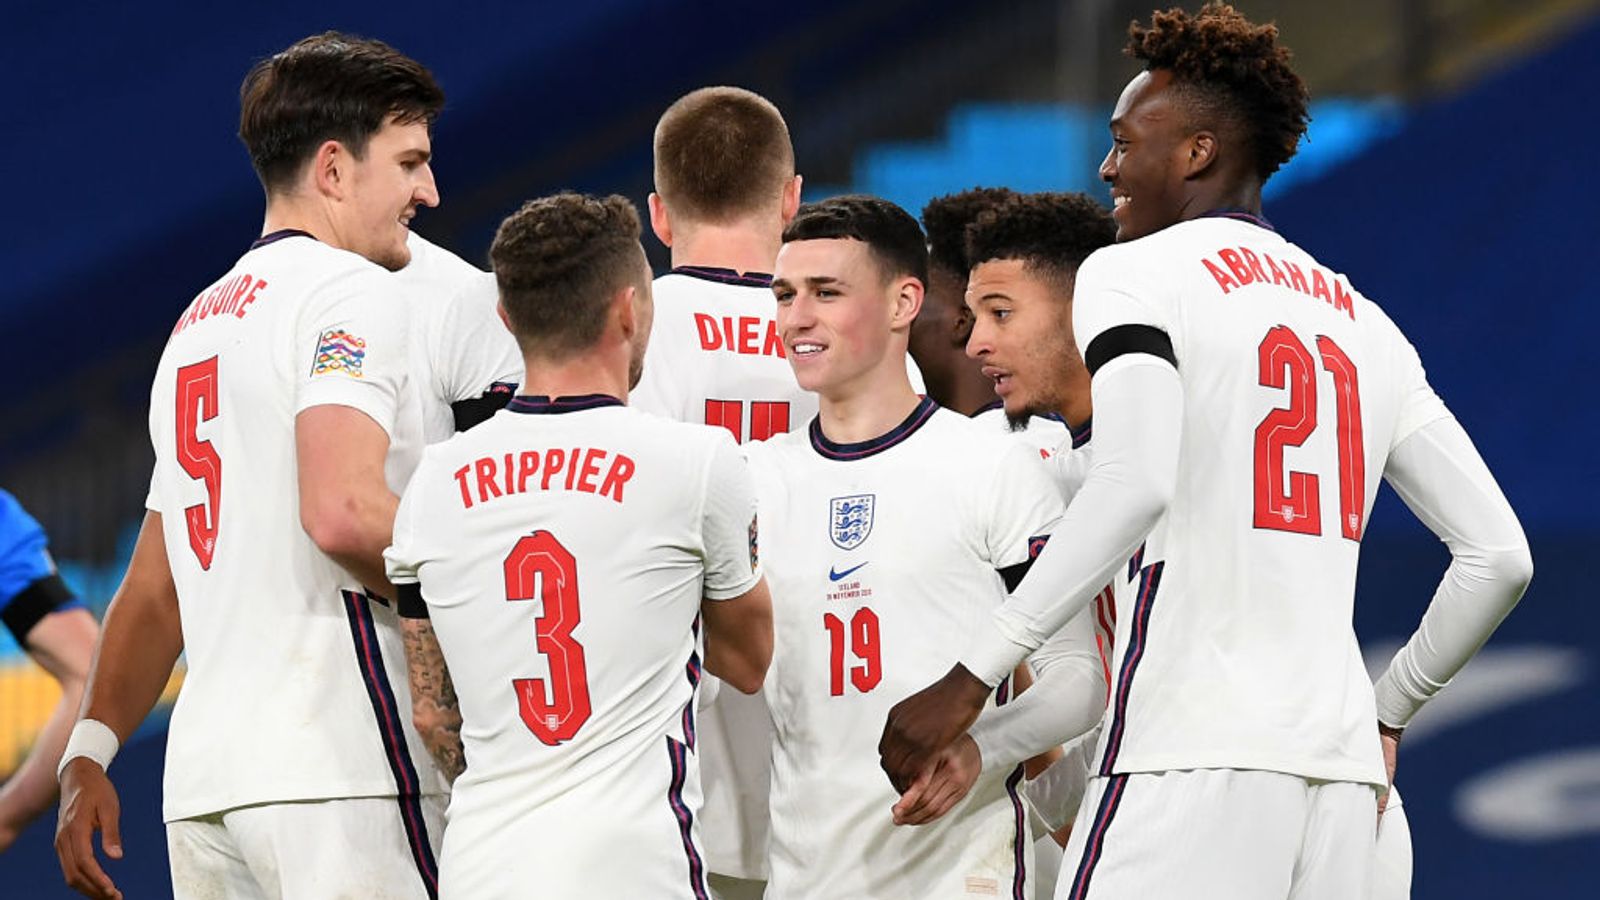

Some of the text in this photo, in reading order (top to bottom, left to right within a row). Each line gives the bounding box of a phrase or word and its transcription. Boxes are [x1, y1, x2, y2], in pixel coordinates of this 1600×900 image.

[1201, 246, 1355, 321] ABRAHAM
[175, 354, 221, 570] 5
[454, 448, 635, 508] TRIPPIER
[1253, 324, 1365, 543] 21
[503, 530, 592, 746] 3
[823, 606, 882, 696] 19
